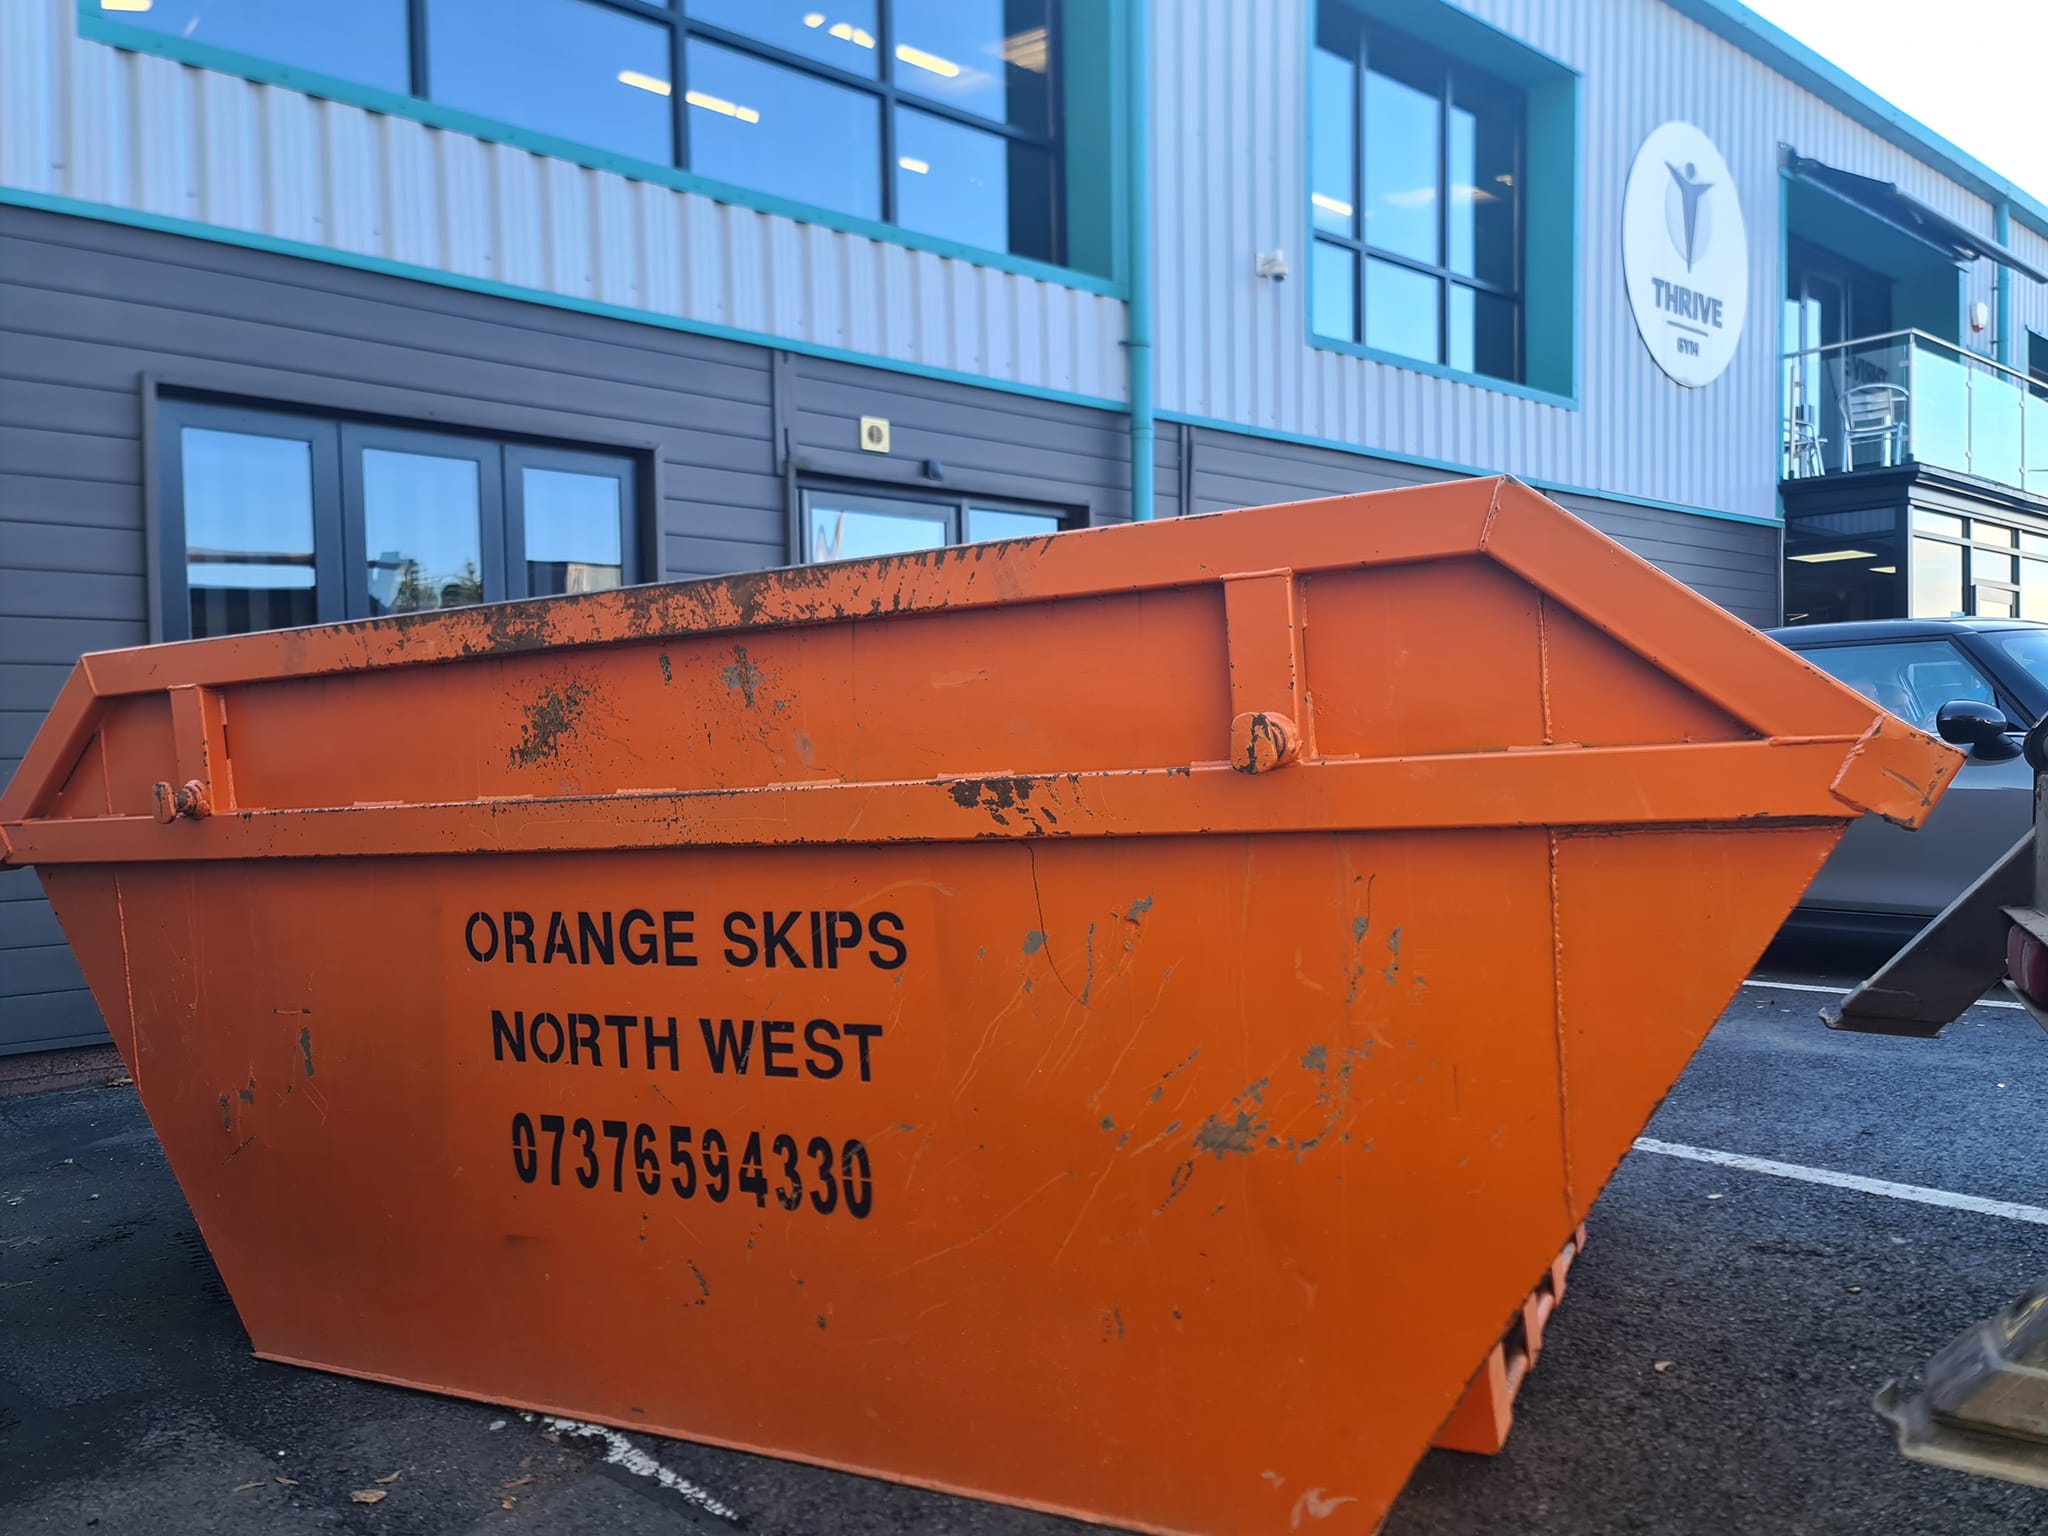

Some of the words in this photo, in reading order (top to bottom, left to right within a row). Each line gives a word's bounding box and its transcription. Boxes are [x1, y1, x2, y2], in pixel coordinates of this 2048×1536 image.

[1652, 277, 1723, 329] THRIVE
[1676, 337, 1699, 357] GYM
[465, 909, 698, 966] ORANGE
[723, 911, 907, 970] SKIPS
[491, 1010, 679, 1071] NORTH
[699, 1018, 883, 1082] WEST
[512, 1112, 873, 1219] 07376594330
